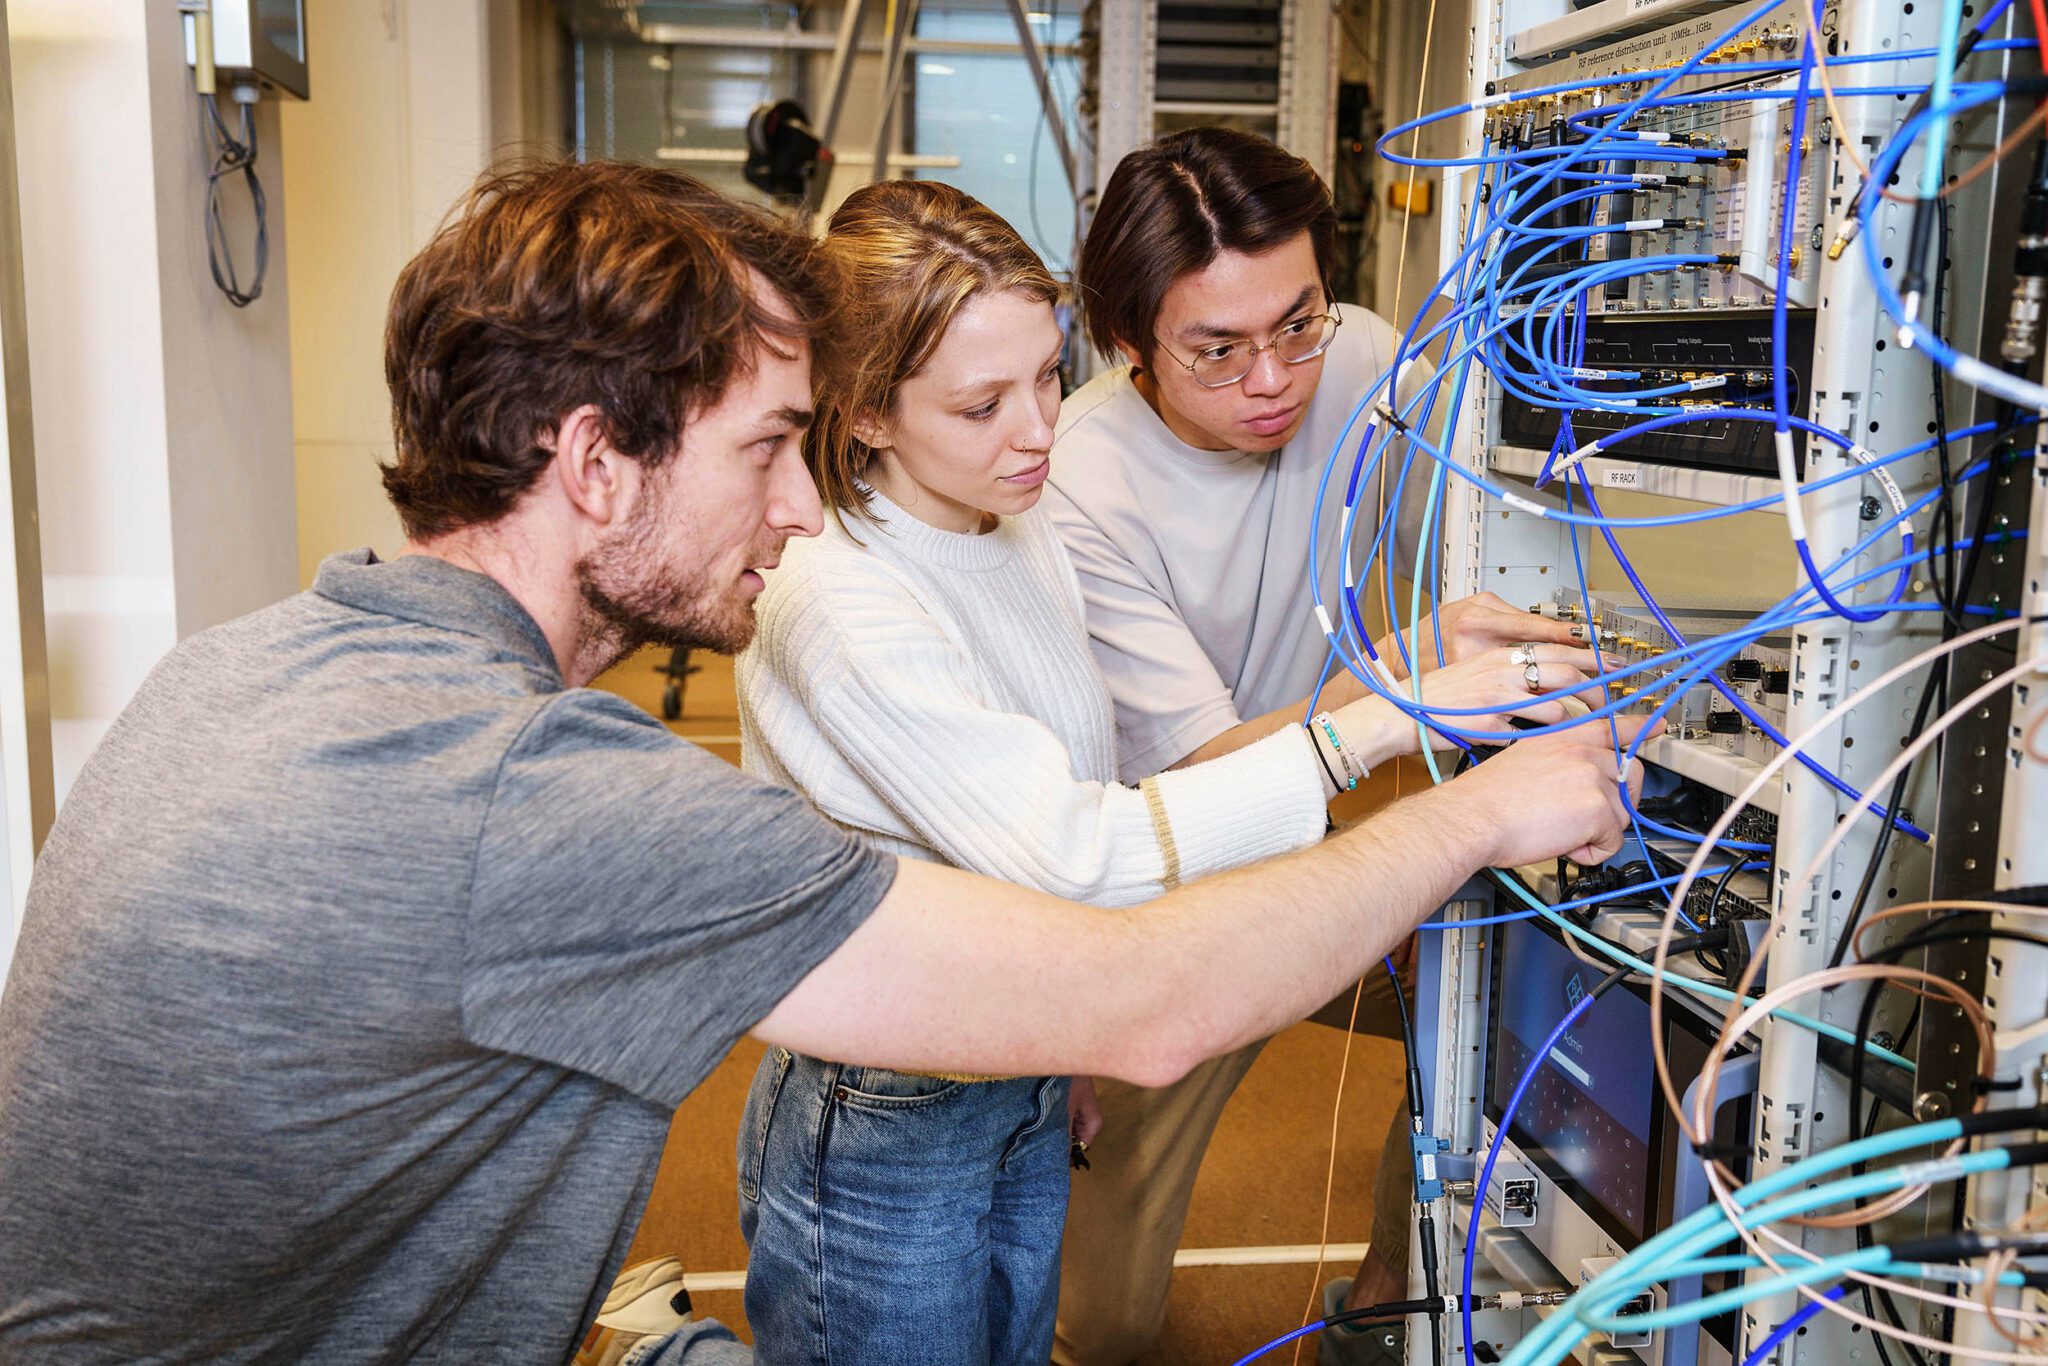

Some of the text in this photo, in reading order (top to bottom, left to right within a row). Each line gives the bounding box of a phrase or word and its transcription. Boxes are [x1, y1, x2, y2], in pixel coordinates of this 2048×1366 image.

[1578, 58, 1587, 69] RF
[1587, 51, 1614, 66] reference
[1615, 39, 1652, 57] distribution
[1653, 33, 1667, 46] unit
[1665, 49, 1672, 59] 10
[1681, 45, 1687, 55] 11
[1697, 41, 1705, 50] 12
[1750, 25, 1758, 36] 15
[1611, 472, 1636, 484] RF RACK
[1563, 1031, 1583, 1055] Admin
